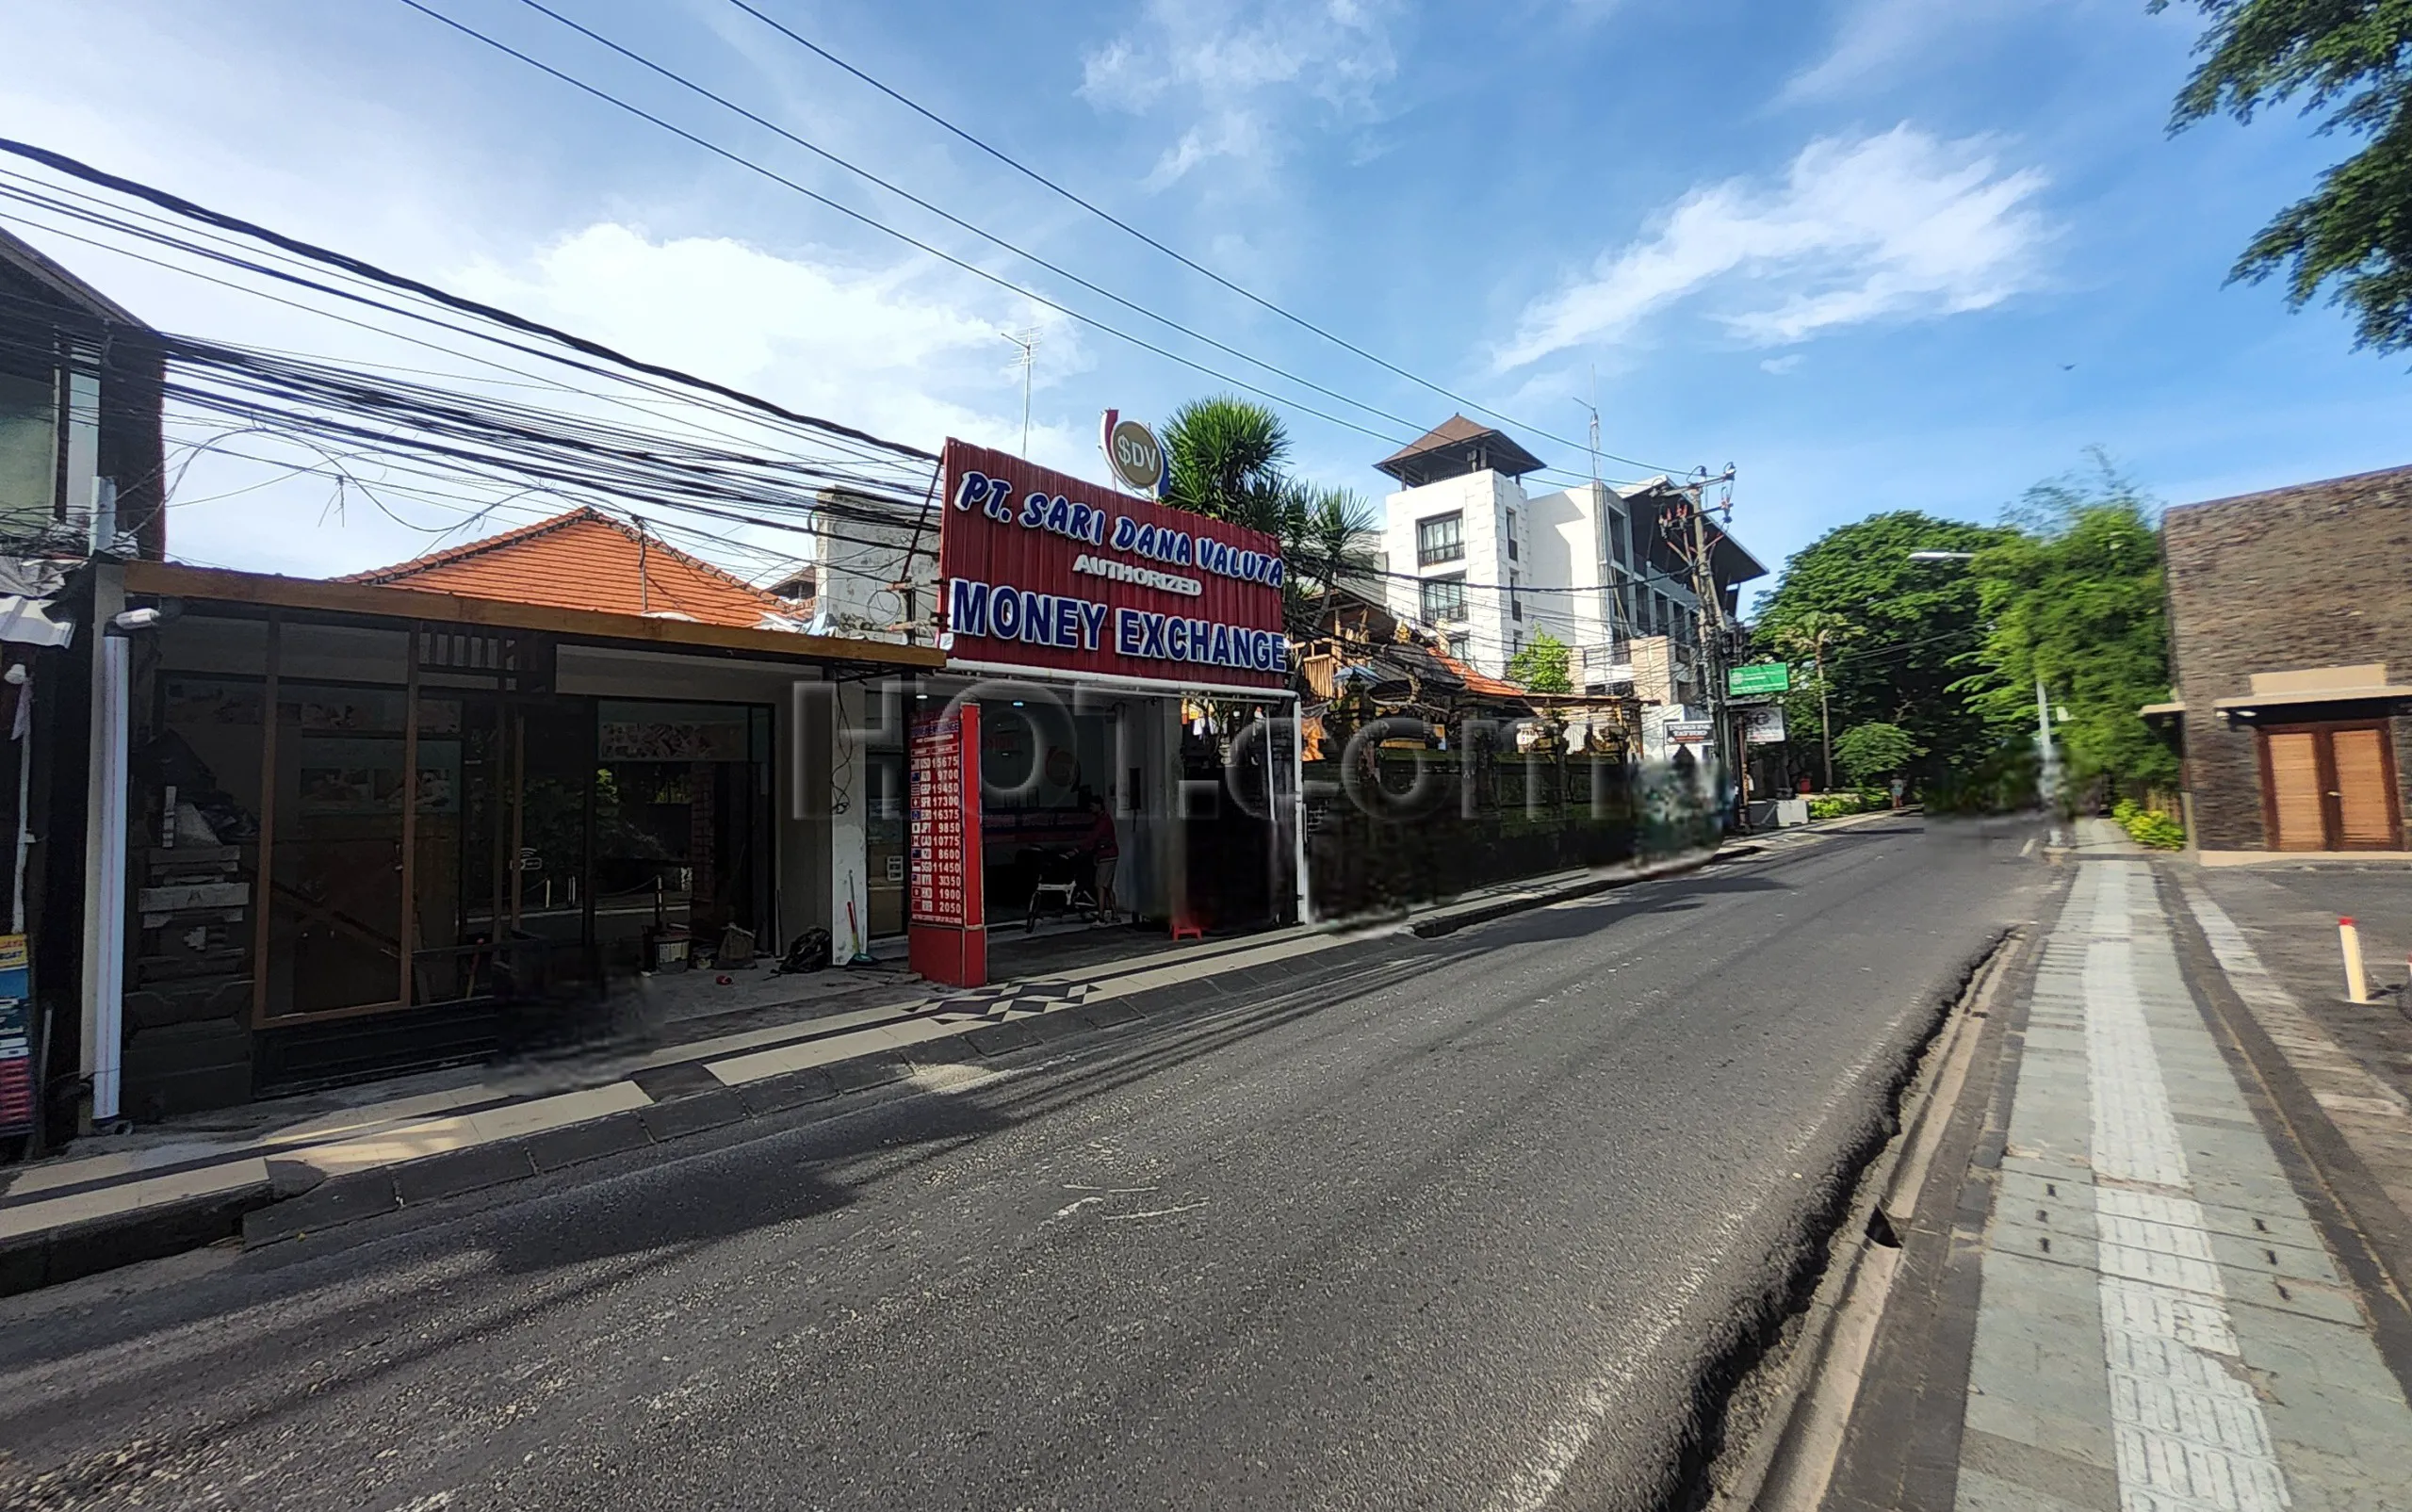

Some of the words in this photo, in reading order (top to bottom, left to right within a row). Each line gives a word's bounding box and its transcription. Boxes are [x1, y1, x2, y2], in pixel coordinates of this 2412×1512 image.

[953, 470, 1013, 524] PT.
[1018, 492, 1106, 546] SARI
[1110, 516, 1192, 567] DANA
[1195, 537, 1285, 589] VALUTA
[1072, 554, 1203, 596] AUTHORIZED
[948, 577, 1107, 651] MONEY
[1115, 608, 1288, 673] EXCHANGE
[932, 756, 958, 768] 15675
[937, 770, 959, 781] 9700
[933, 783, 959, 794] 19450
[933, 796, 959, 806] 17300
[933, 809, 959, 820] 16375
[938, 822, 960, 833] 9850
[934, 836, 960, 846] 10775
[938, 849, 960, 859] 8600
[934, 862, 960, 873] 11450
[939, 888, 961, 900] 1900
[939, 902, 961, 914] 2050
